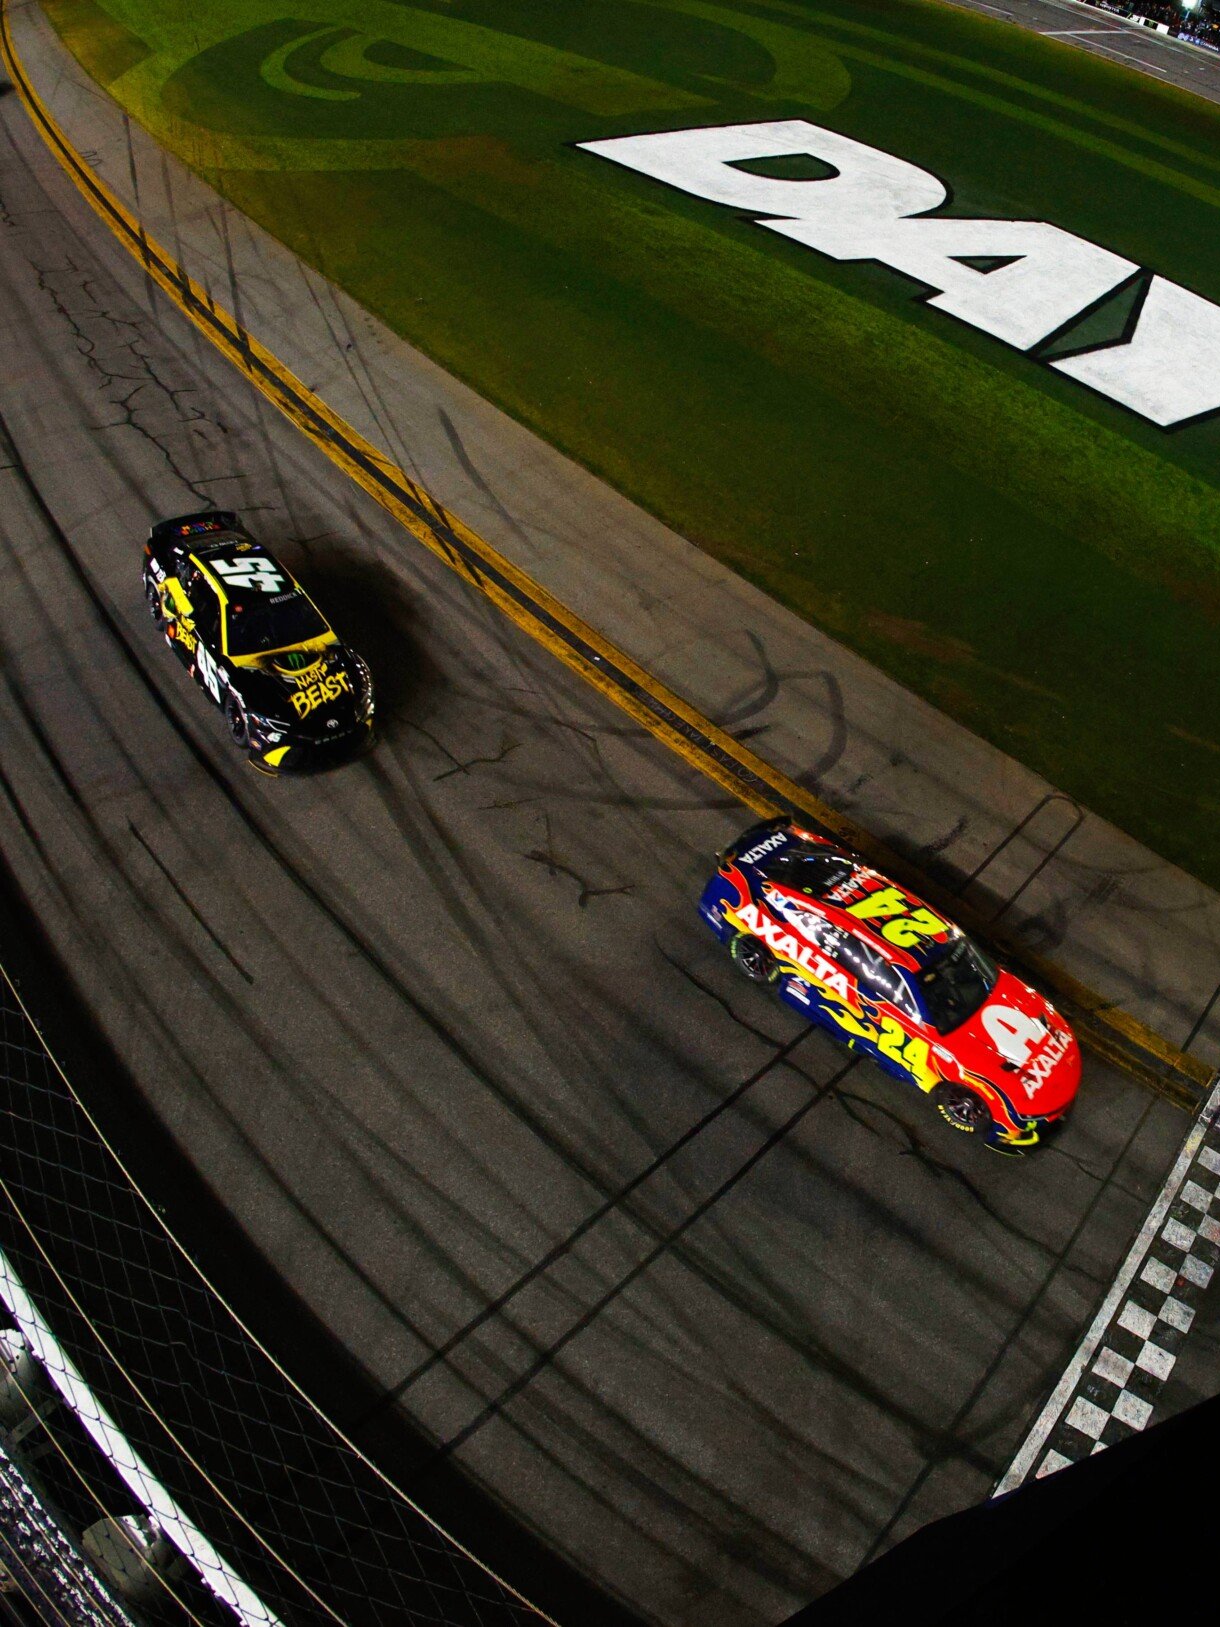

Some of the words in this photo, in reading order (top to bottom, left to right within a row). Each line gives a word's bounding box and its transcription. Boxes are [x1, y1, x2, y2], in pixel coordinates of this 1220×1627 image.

[209, 557, 287, 593] 45
[196, 640, 221, 703] 45
[289, 671, 349, 719] BEAST
[295, 662, 328, 689] NASTY
[739, 831, 788, 864] AXALTA
[827, 867, 871, 902] AXALTA
[846, 886, 948, 948] 24
[737, 903, 850, 1000] AXALTA
[878, 1016, 930, 1085] 24
[1019, 1030, 1073, 1099] AXALTA
